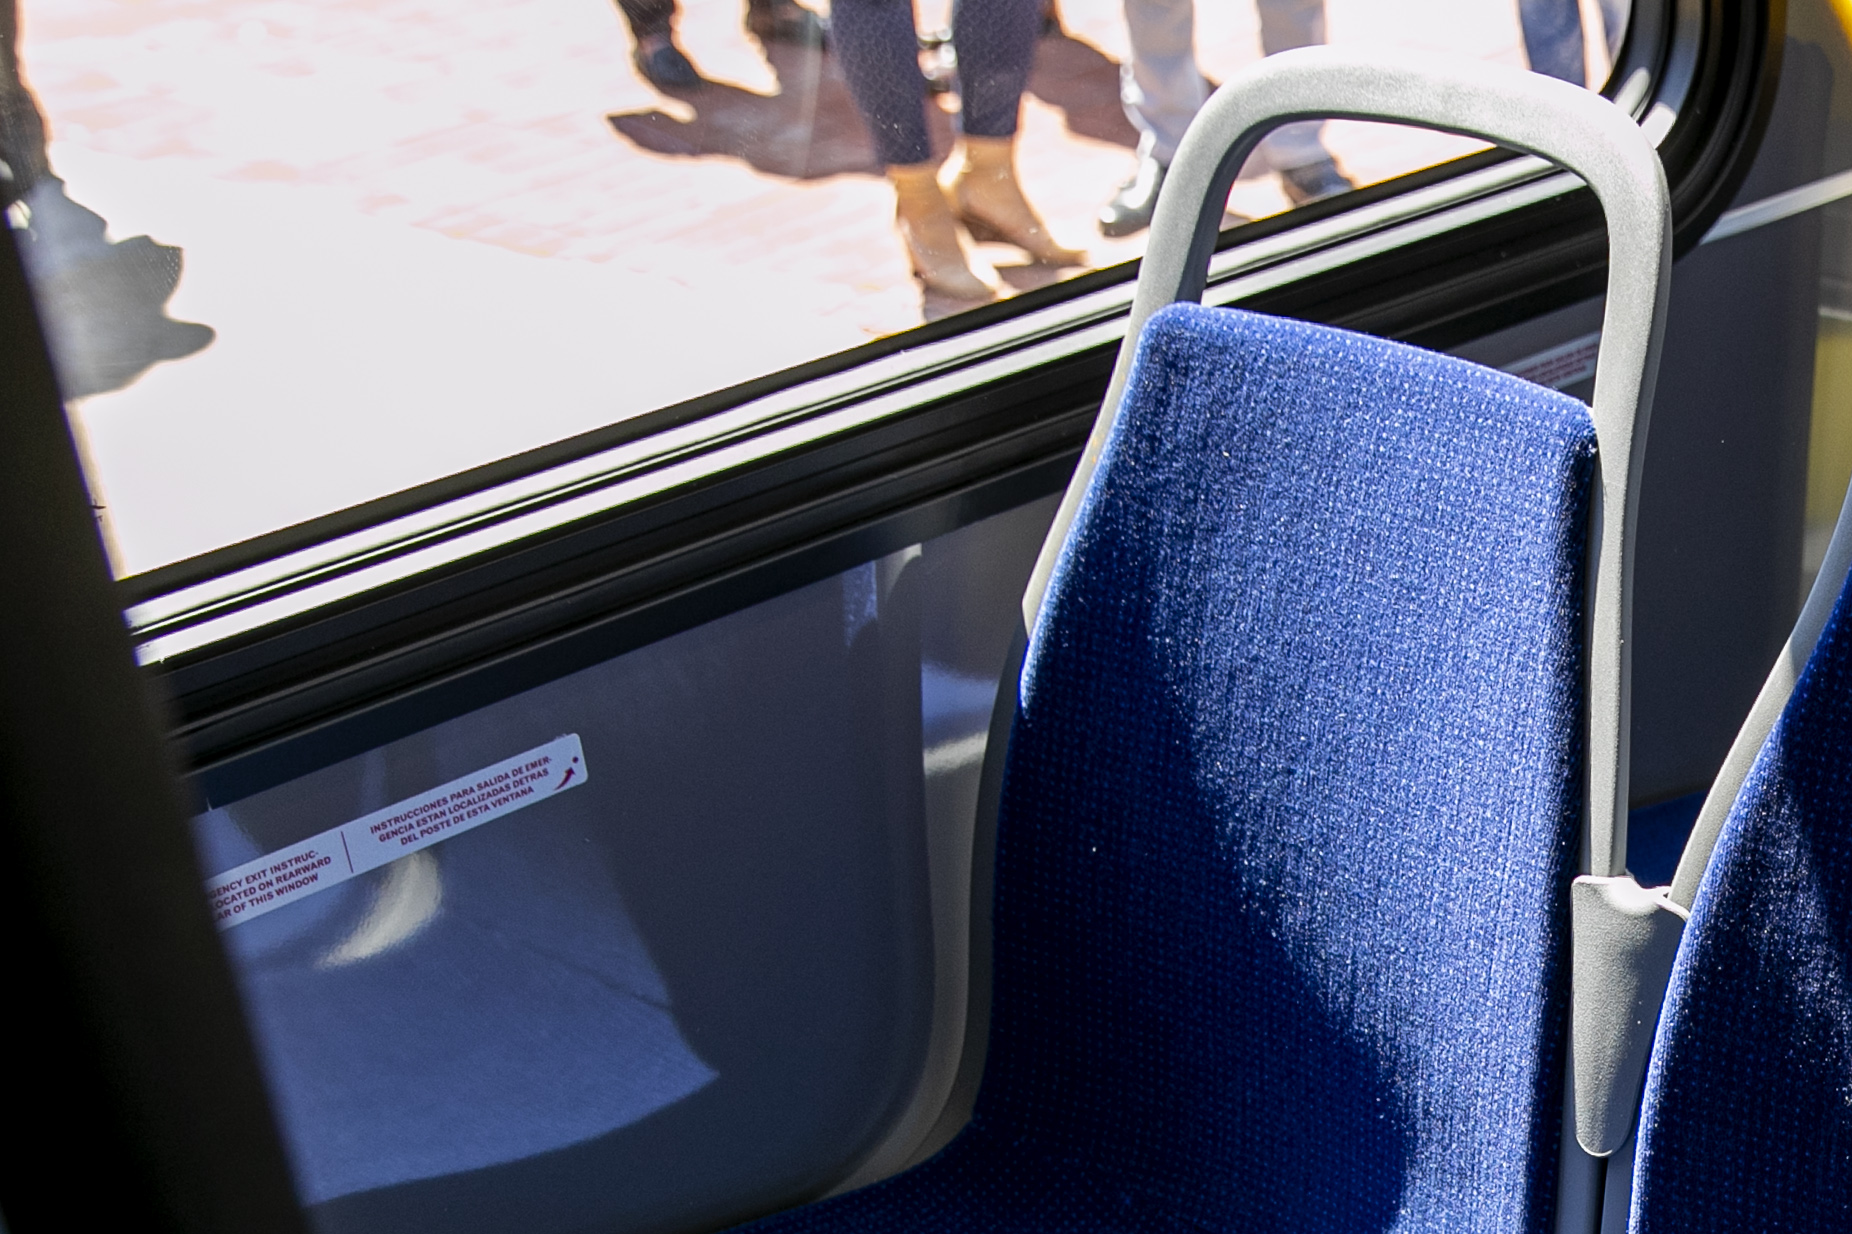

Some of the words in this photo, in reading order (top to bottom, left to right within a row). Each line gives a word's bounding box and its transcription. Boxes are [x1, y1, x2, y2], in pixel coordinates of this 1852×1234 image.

[370, 797, 449, 834] INSTRUCCIONES
[450, 786, 475, 802] PARA
[477, 773, 510, 791] SALIDA
[512, 766, 524, 778] DE
[526, 756, 552, 772] EMER-
[378, 822, 415, 843] GENCIA
[417, 810, 447, 829] ESTAN
[448, 785, 511, 814] LOCALIZADAS
[512, 768, 549, 789] DETRAS
[400, 833, 419, 845] DEL
[420, 820, 451, 837] POSTE
[453, 813, 465, 825] DE
[466, 804, 490, 819] ESTA
[491, 786, 534, 808] VENTANA
[209, 879, 242, 899] GENCY
[245, 869, 267, 884] EXIT
[270, 850, 319, 875] INSTRUC-
[214, 887, 256, 909] OCATED
[258, 880, 274, 894] ON
[276, 856, 332, 884] REARWARD
[233, 901, 247, 914] OF
[249, 892, 274, 908] THIS
[275, 873, 319, 896] WINDOW
